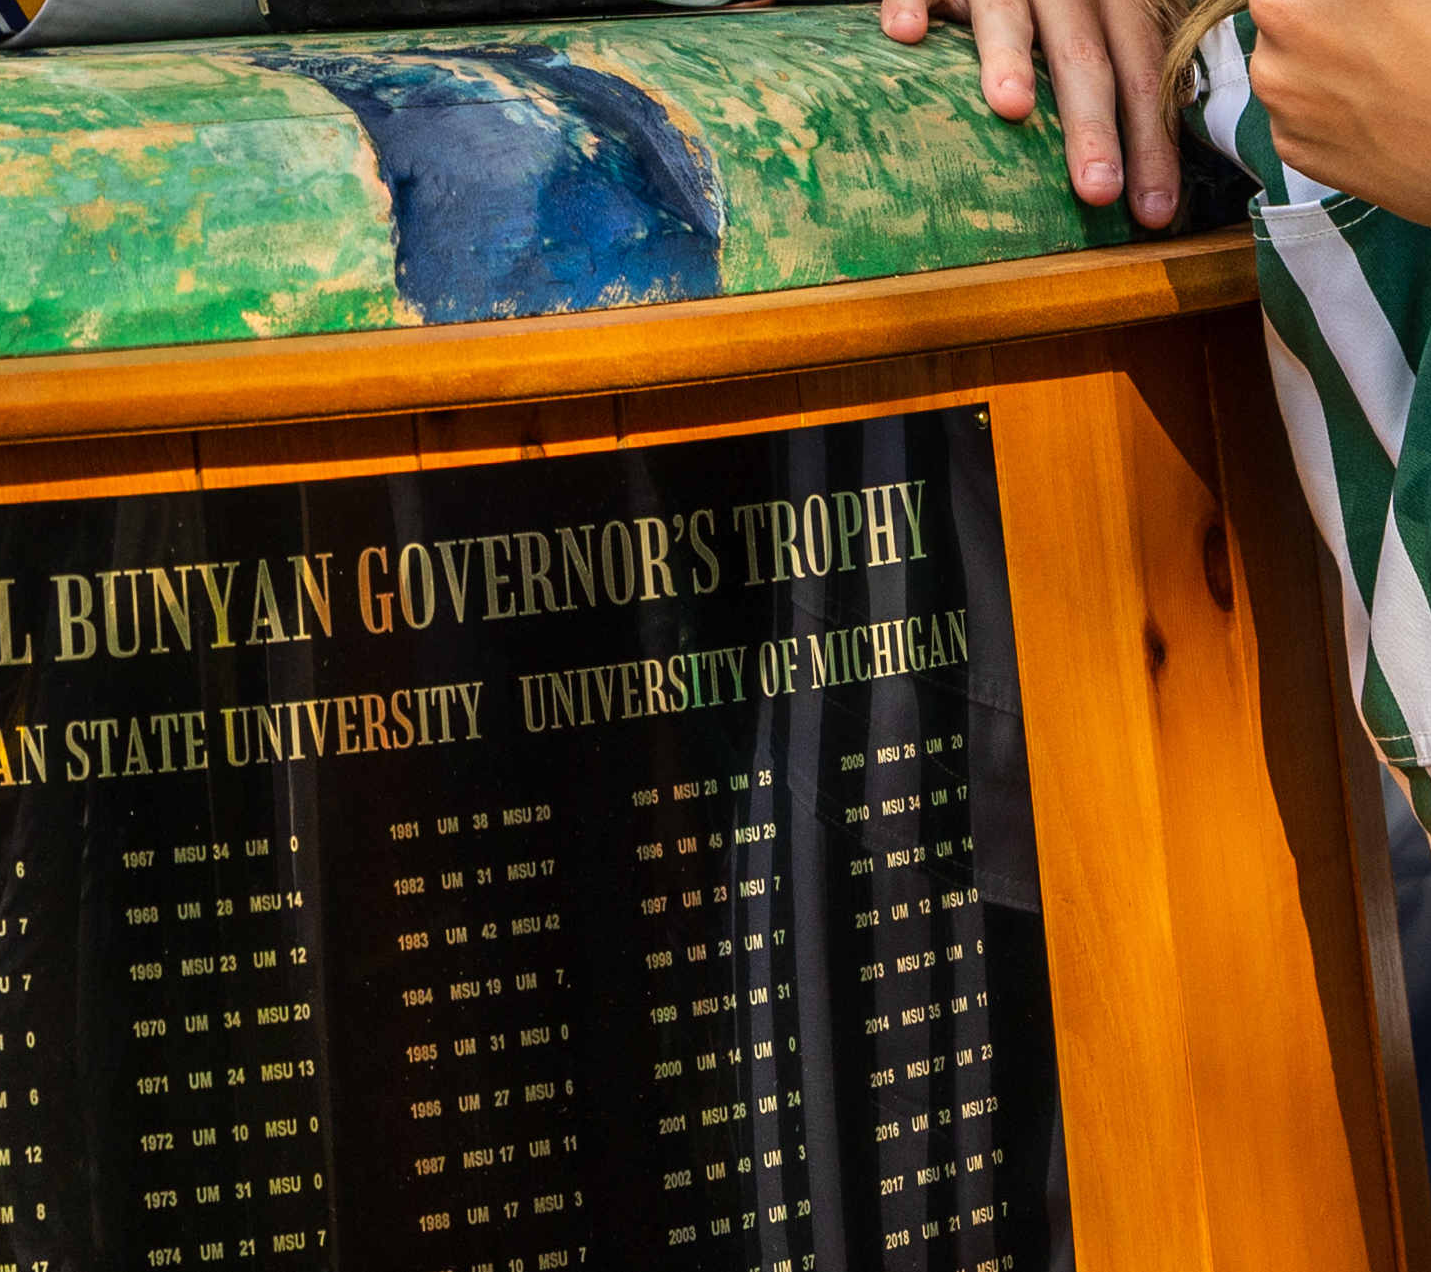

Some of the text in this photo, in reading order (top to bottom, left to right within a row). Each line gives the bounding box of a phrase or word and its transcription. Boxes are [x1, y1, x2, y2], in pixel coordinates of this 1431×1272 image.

[50, 552, 333, 662] BUNYAN
[357, 509, 720, 635] GOVERNOR'S
[733, 479, 927, 587] TROPHY
[65, 710, 210, 782] STATE
[221, 682, 484, 768] UNIVERSITY
[519, 646, 748, 733] UNIVERSITY
[759, 634, 799, 698] OF
[806, 608, 970, 690] MICHIGAN
[840, 733, 963, 771] 2009 MSU 26 UM 20
[631, 769, 773, 807] 1995 MSU 28 UM 25
[389, 804, 551, 841] 1981 UM 38 MSU 20
[173, 844, 207, 864] MSU
[212, 842, 230, 861] 34
[245, 838, 269, 857] UM
[289, 834, 300, 853] 0
[636, 822, 777, 862] 1996 UM 45 MSU 29
[15, 860, 26, 880] 6
[393, 859, 555, 896] 1982 UM 31 MSU 17
[18, 917, 29, 935] 7
[125, 890, 304, 925] 1968 UM 28 MSU 14
[855, 887, 979, 929] 2012 UM 12 MSU 10
[397, 913, 560, 952] 1983 UM 42 MSU 42
[21, 973, 32, 992] 7
[129, 946, 308, 982] 1969 MSU 23 UM 12
[132, 1002, 311, 1038] 1970 UM 34 MSU 20
[865, 990, 988, 1035] 2014 MSU 35 UM 11
[25, 1030, 36, 1049] 0
[136, 1059, 315, 1095] 1971 UM 24 MSU 13
[869, 1043, 994, 1088] 2015 MSU 27 UM 23
[28, 1087, 40, 1106] 6
[658, 1090, 802, 1135] 2001 MSU 26 UM 24
[140, 1115, 319, 1152] 1972 UM 10 MSU 0
[875, 1096, 999, 1142] 2016 UM 32 MSU 23
[24, 1145, 43, 1164] 12
[414, 1134, 578, 1176] 1987 MSU 17 UM 11
[143, 1172, 323, 1210] 1973 UM 31 MSU 0
[35, 1202, 47, 1221] 8
[147, 1229, 327, 1267] 1974 UM 21 MSU 7
